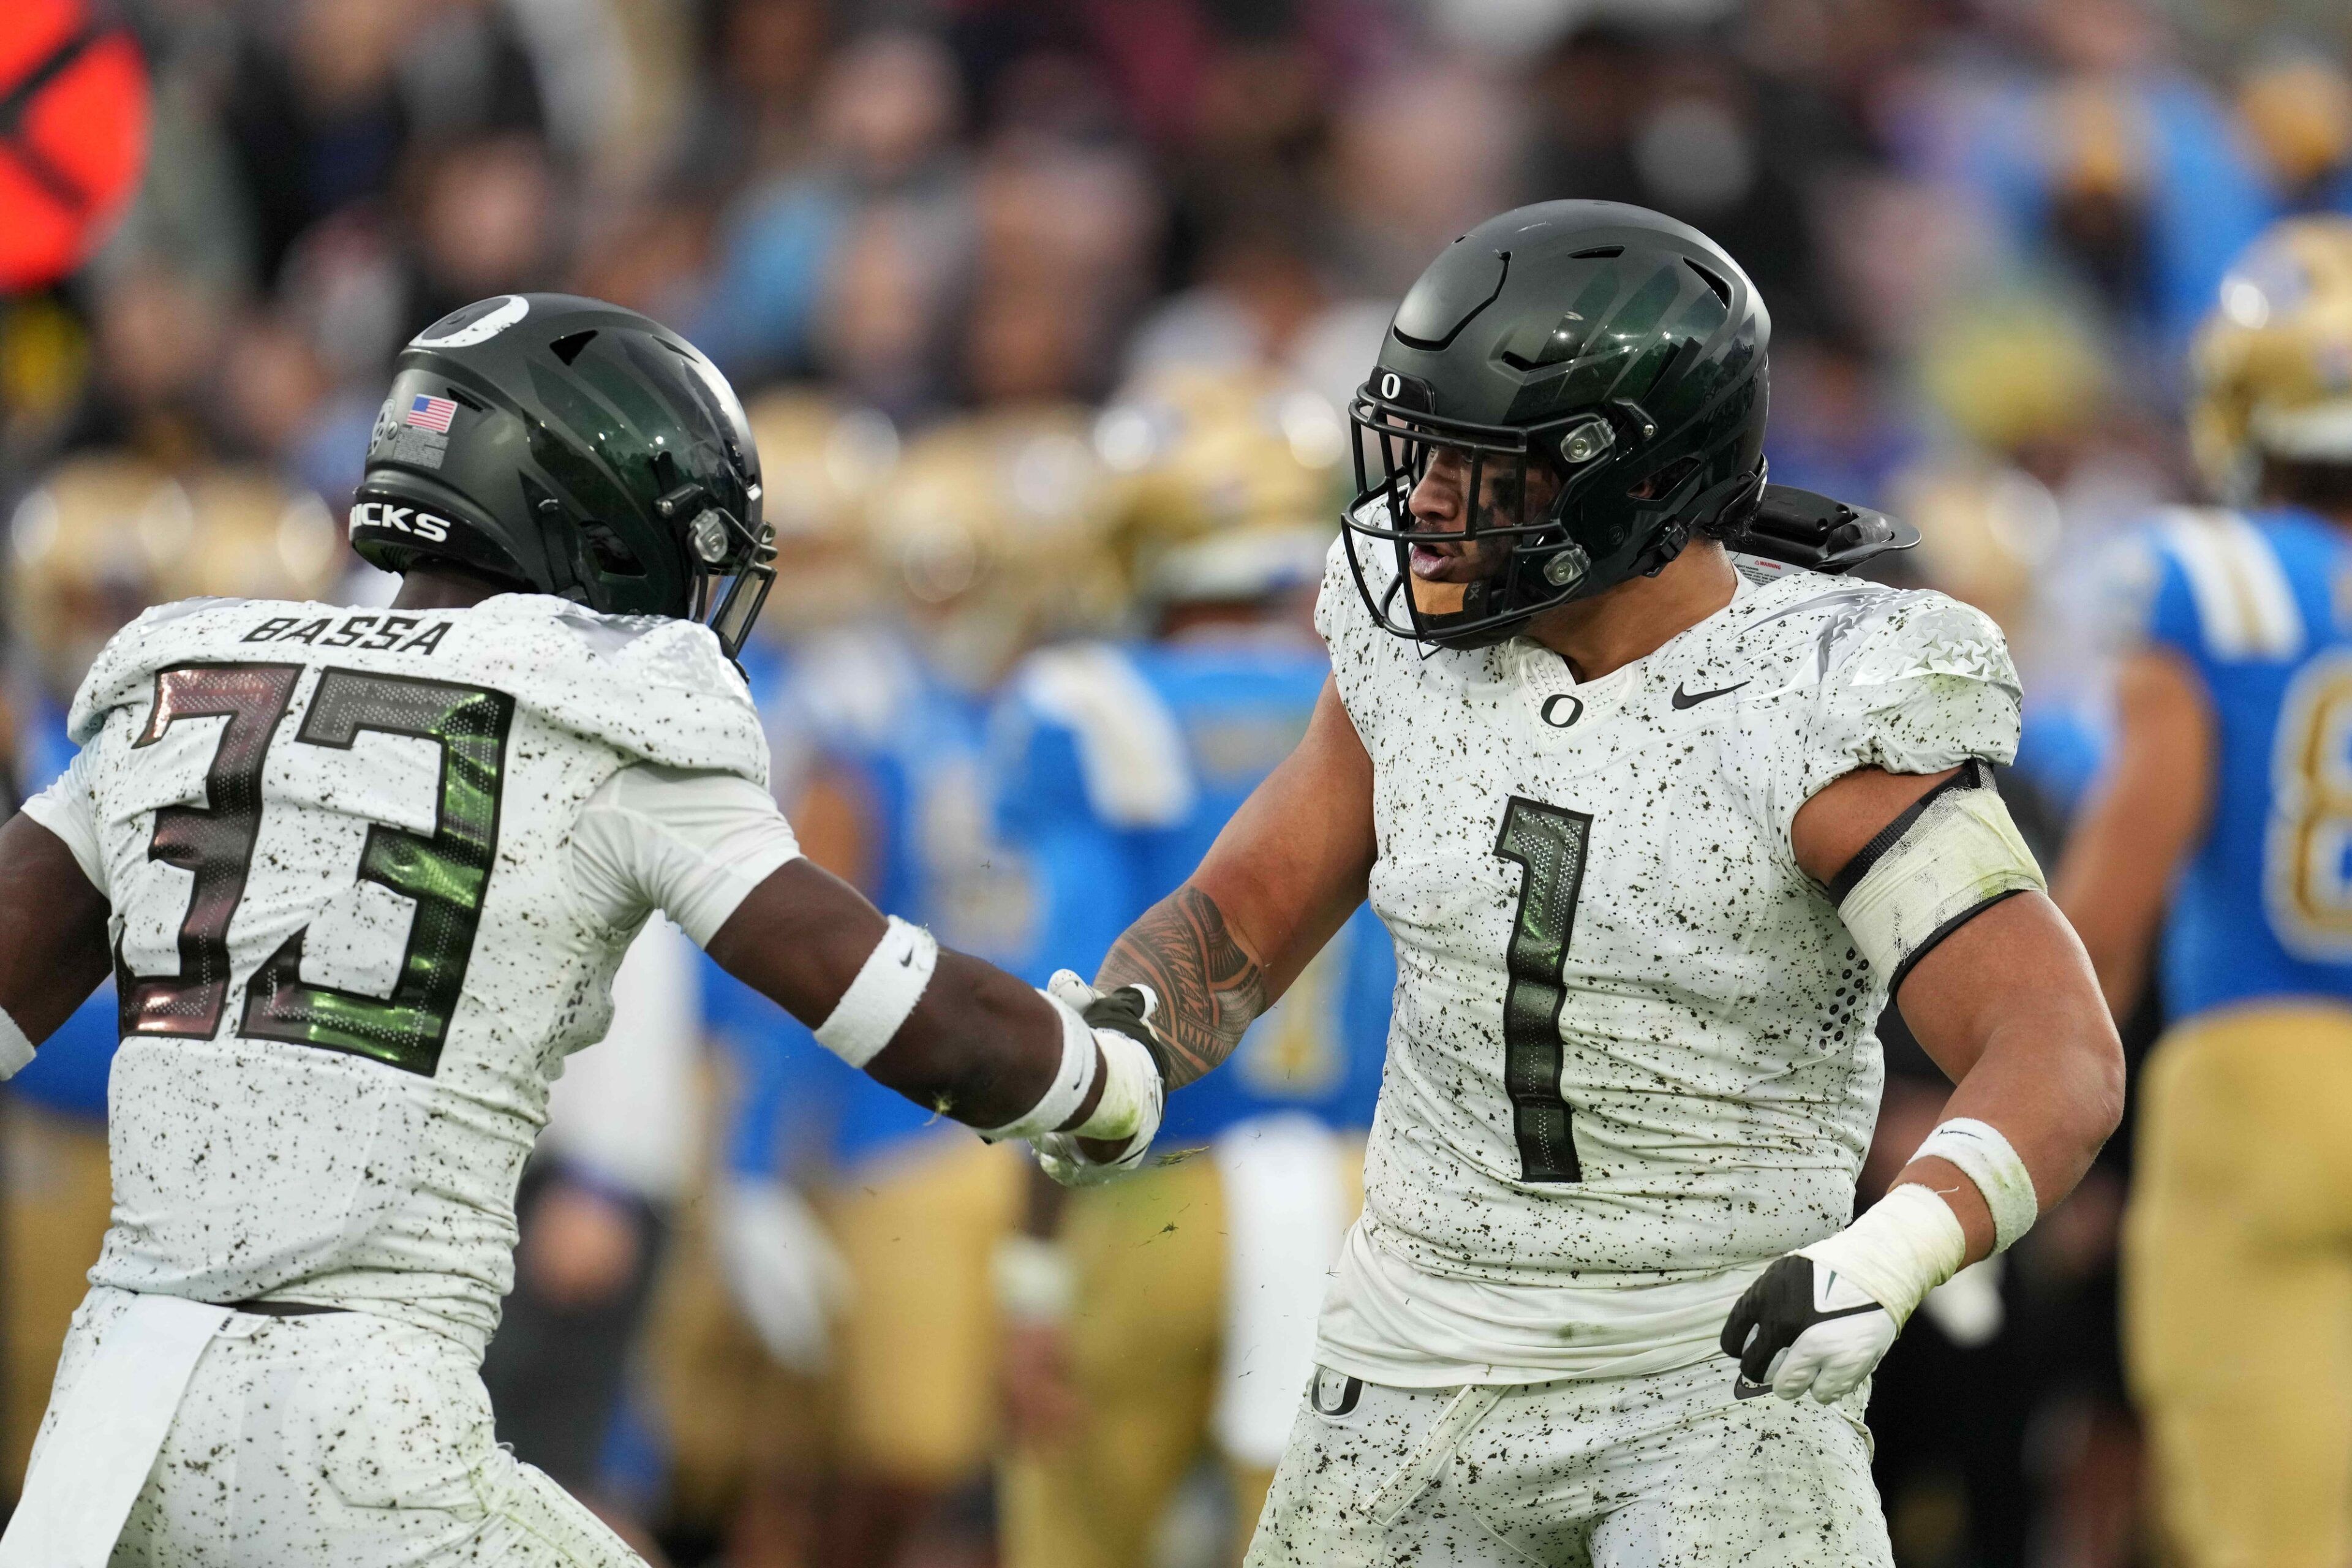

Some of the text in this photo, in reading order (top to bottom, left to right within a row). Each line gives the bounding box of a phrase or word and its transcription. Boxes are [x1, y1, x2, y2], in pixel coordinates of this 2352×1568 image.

[1760, 561, 1781, 570] WARNING
[239, 616, 453, 656] BASSA
[1540, 694, 1583, 728] O
[113, 661, 516, 1078] 33
[1492, 795, 1594, 1183] 1
